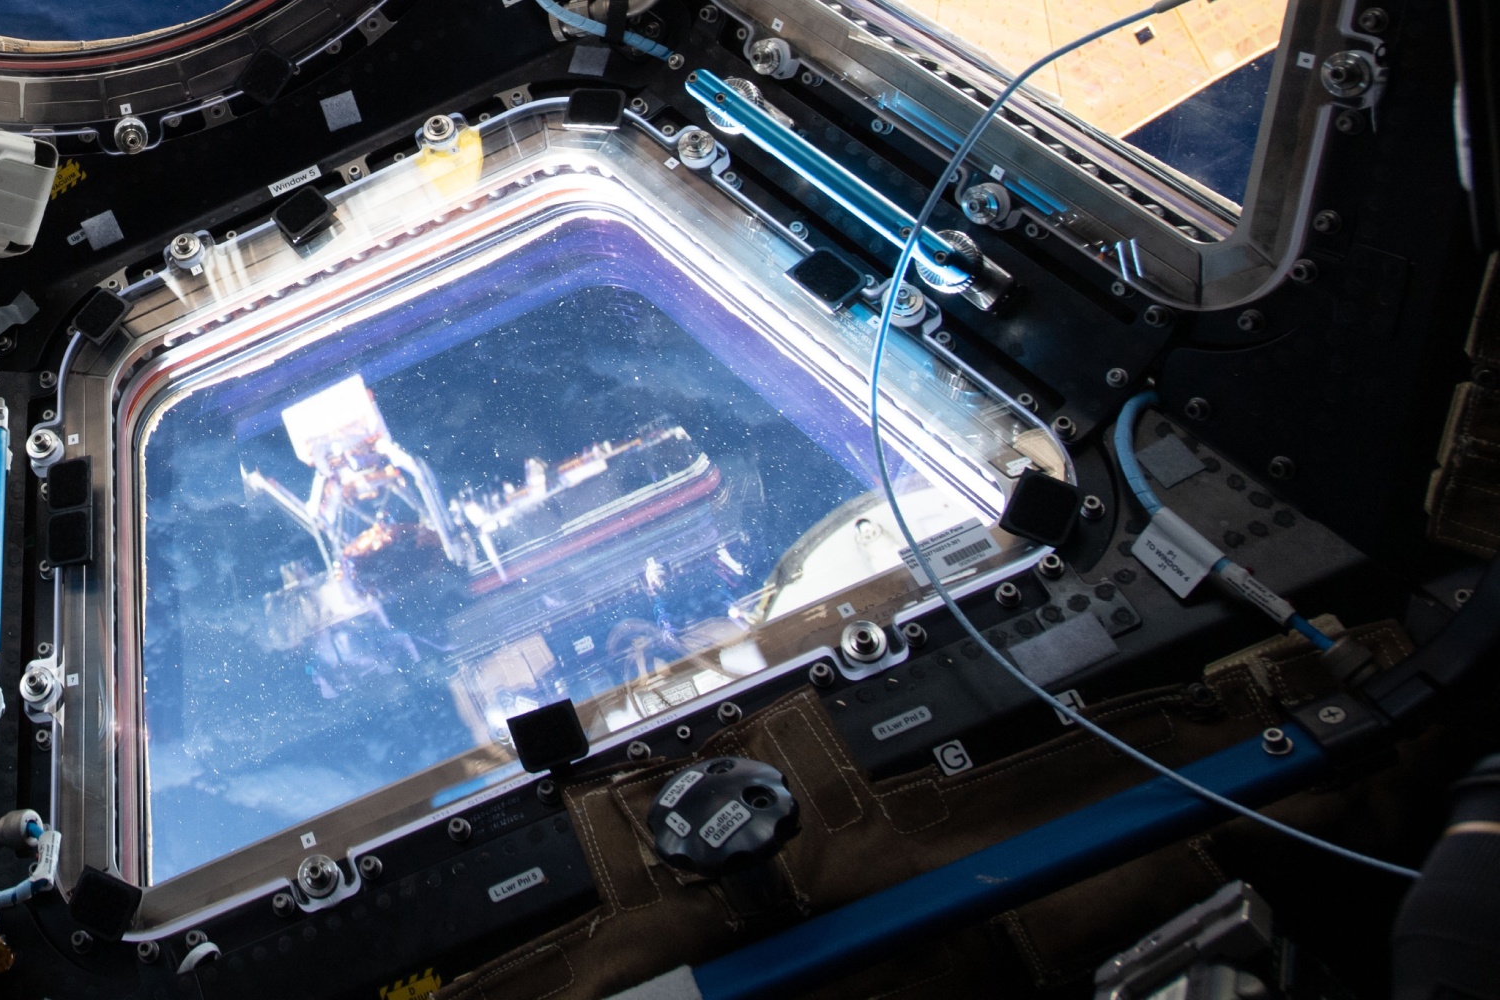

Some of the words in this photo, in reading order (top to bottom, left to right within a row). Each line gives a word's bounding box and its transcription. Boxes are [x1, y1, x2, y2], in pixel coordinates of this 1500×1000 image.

[272, 172, 308, 193] Window
[307, 168, 316, 177] 5
[70, 233, 80, 242] Up
[899, 547, 911, 556] Side
[929, 530, 950, 543] Scratch
[949, 524, 963, 534] Pane
[906, 557, 916, 565] P/N
[1144, 539, 1156, 551] TO
[1153, 548, 1185, 577] WINDOW
[1166, 549, 1177, 560] P1
[1157, 561, 1167, 571] J1
[878, 726, 886, 735] R
[886, 719, 903, 732] Lwr
[903, 713, 918, 725] Pnl
[918, 710, 926, 718] 5
[937, 740, 968, 773] G
[729, 802, 740, 812] or
[701, 824, 715, 838] OP
[712, 810, 744, 842] CLOSED
[493, 889, 501, 897] L
[500, 881, 516, 894] Lwr
[516, 875, 531, 887] Pnl
[531, 872, 538, 880] 5
[408, 986, 416, 995] D
